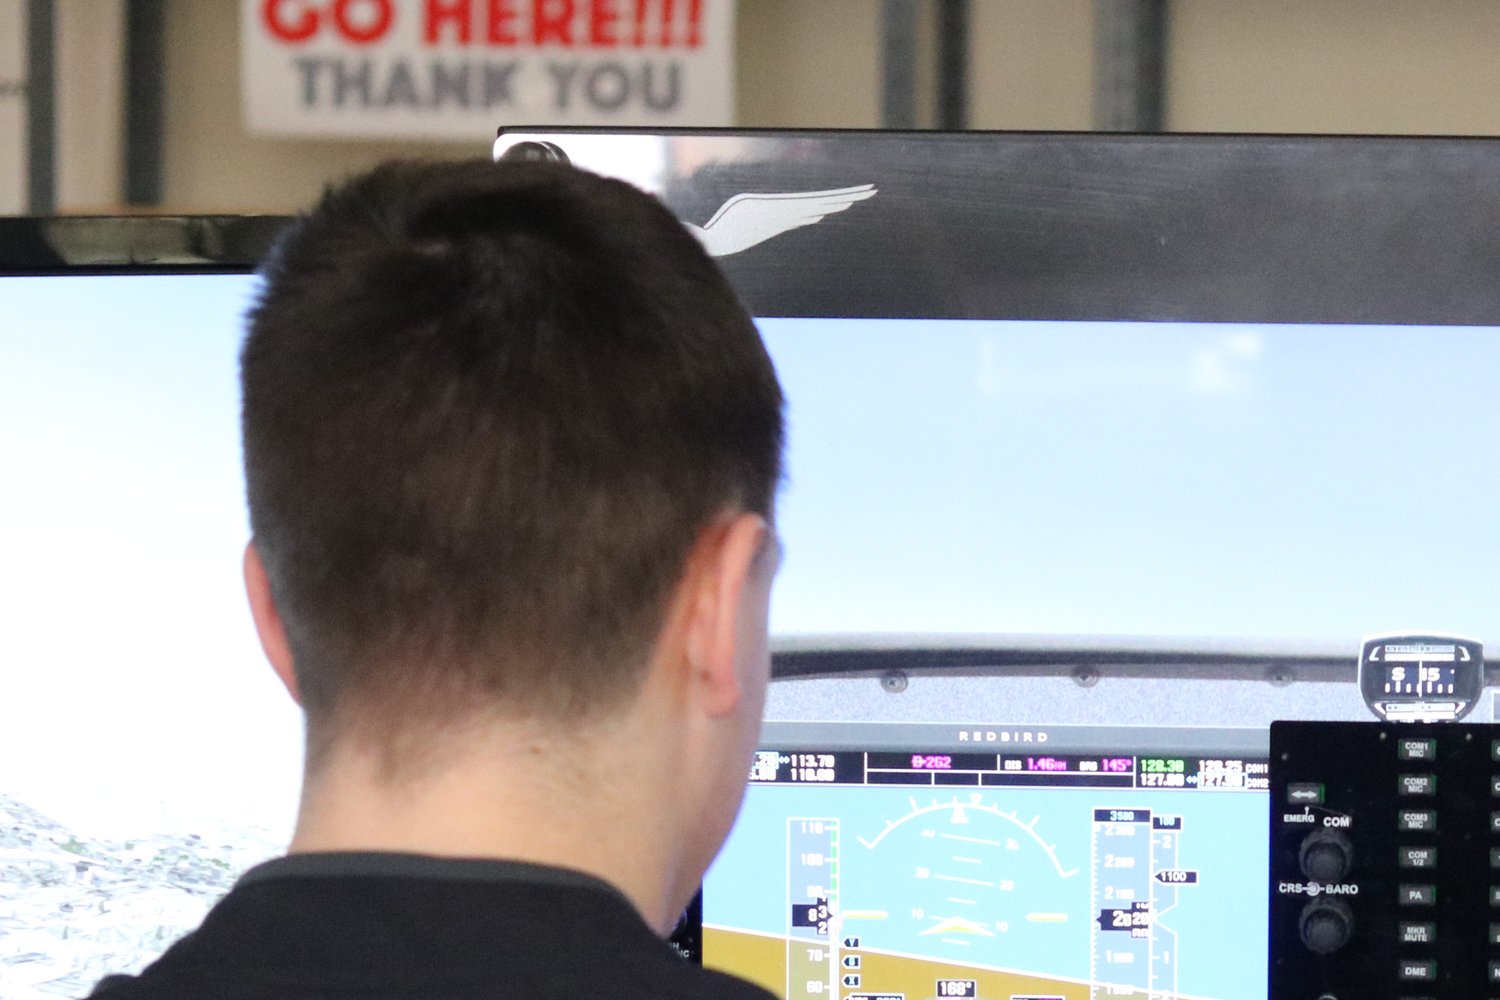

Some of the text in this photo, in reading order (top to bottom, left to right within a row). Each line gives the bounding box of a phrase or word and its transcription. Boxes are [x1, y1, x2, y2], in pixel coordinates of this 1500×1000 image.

[263, 0, 393, 45] GO
[291, 57, 683, 114] THANK YOU
[959, 731, 1048, 743] REDBIRD
[1405, 742, 1428, 750] COM1
[1283, 814, 1315, 823] EMERG
[1404, 813, 1428, 821] COM3
[1323, 817, 1349, 827] COM
[1278, 883, 1358, 894] CRS BARO
[1409, 891, 1422, 899] PA
[1404, 934, 1428, 942] MUTE
[1405, 967, 1426, 976] DME
